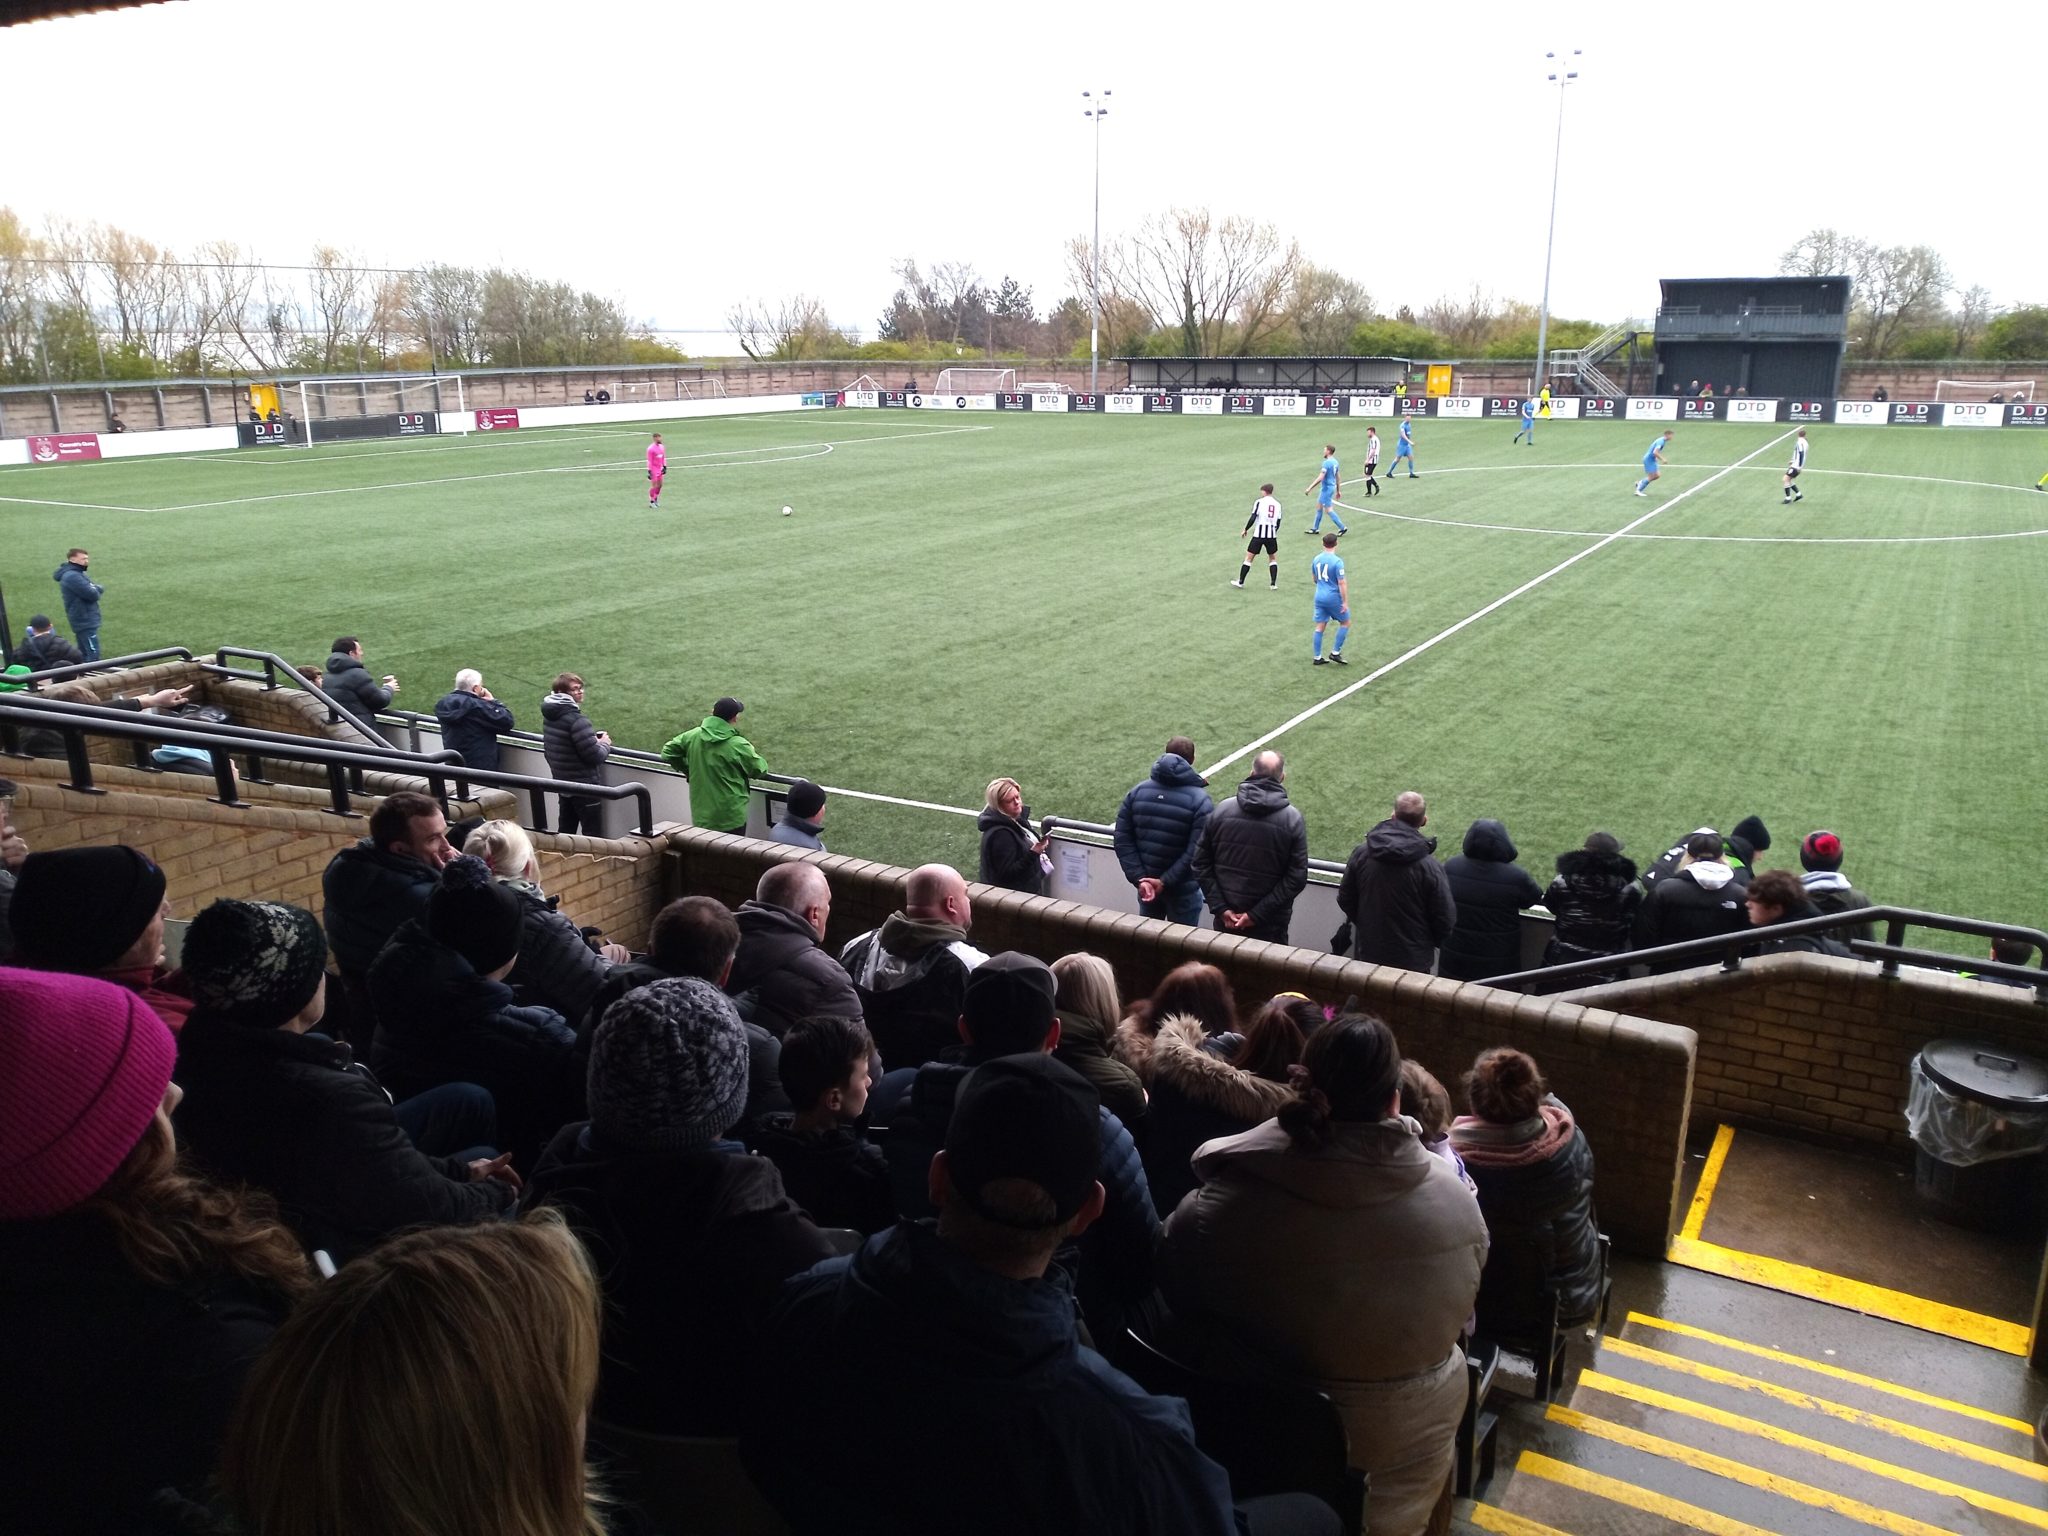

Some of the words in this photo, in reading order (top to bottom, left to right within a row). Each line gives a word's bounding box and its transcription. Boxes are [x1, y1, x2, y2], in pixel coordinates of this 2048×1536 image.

[1113, 397, 1133, 405] DTD
[1151, 397, 1173, 405] DTD
[1191, 397, 1212, 405] DTD
[1231, 398, 1254, 406] DTD
[1273, 398, 1296, 406] DTD
[1315, 398, 1340, 407] DTD
[1359, 398, 1382, 407] DTD
[1401, 398, 1427, 408] DTD
[1445, 399, 1471, 408] DTD
[1491, 399, 1518, 409] DTD
[1586, 399, 1615, 410] DTD
[1636, 400, 1663, 410] DTD
[1685, 401, 1715, 411] DTD
[1737, 402, 1766, 411] DTD
[1790, 402, 1822, 413] DTD
[1842, 403, 1873, 413] DTD
[1896, 404, 1929, 415] DTD
[1954, 405, 1987, 415] DTD
[2012, 405, 2048, 416] DTD
[254, 423, 284, 435] DTD
[1268, 505, 1275, 518] 9
[1316, 562, 1329, 582] 14
